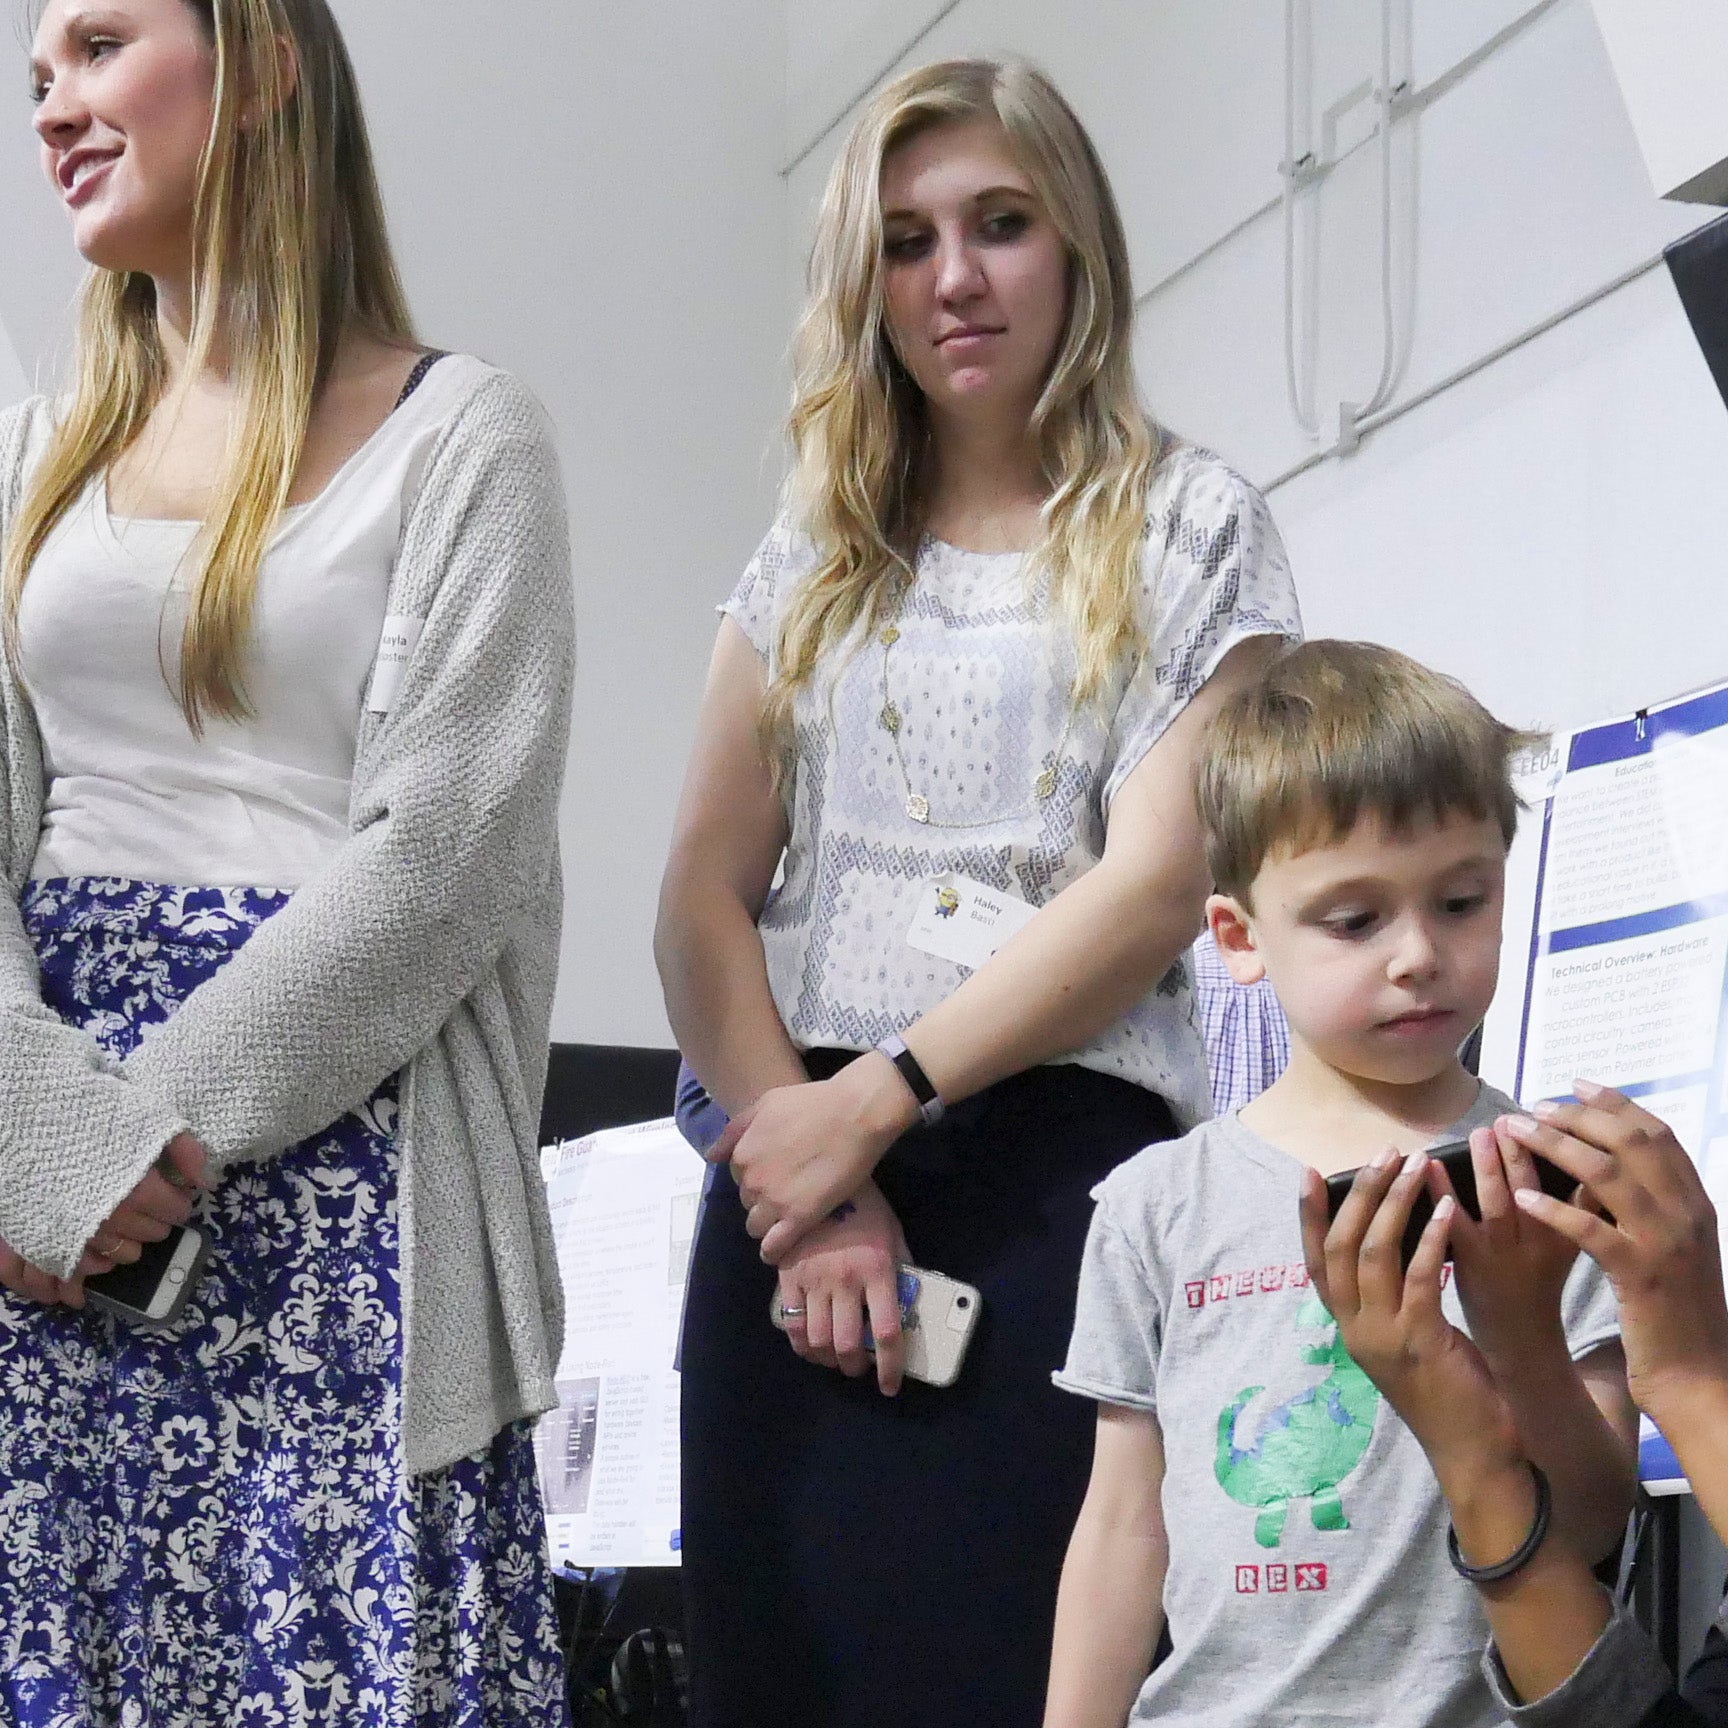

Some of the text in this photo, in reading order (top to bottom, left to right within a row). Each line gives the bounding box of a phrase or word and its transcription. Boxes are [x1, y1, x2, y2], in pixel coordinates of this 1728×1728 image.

[974, 895, 1003, 915] Haley
[1552, 958, 1603, 979] Technical
[1660, 936, 1710, 957] Hardware
[1563, 974, 1613, 995] designed
[1626, 965, 1664, 983] battery
[1562, 995, 1601, 1012] custom
[1604, 989, 1626, 1004] PCB
[1544, 1032, 1582, 1050] control
[1235, 1562, 1328, 1594] REX
